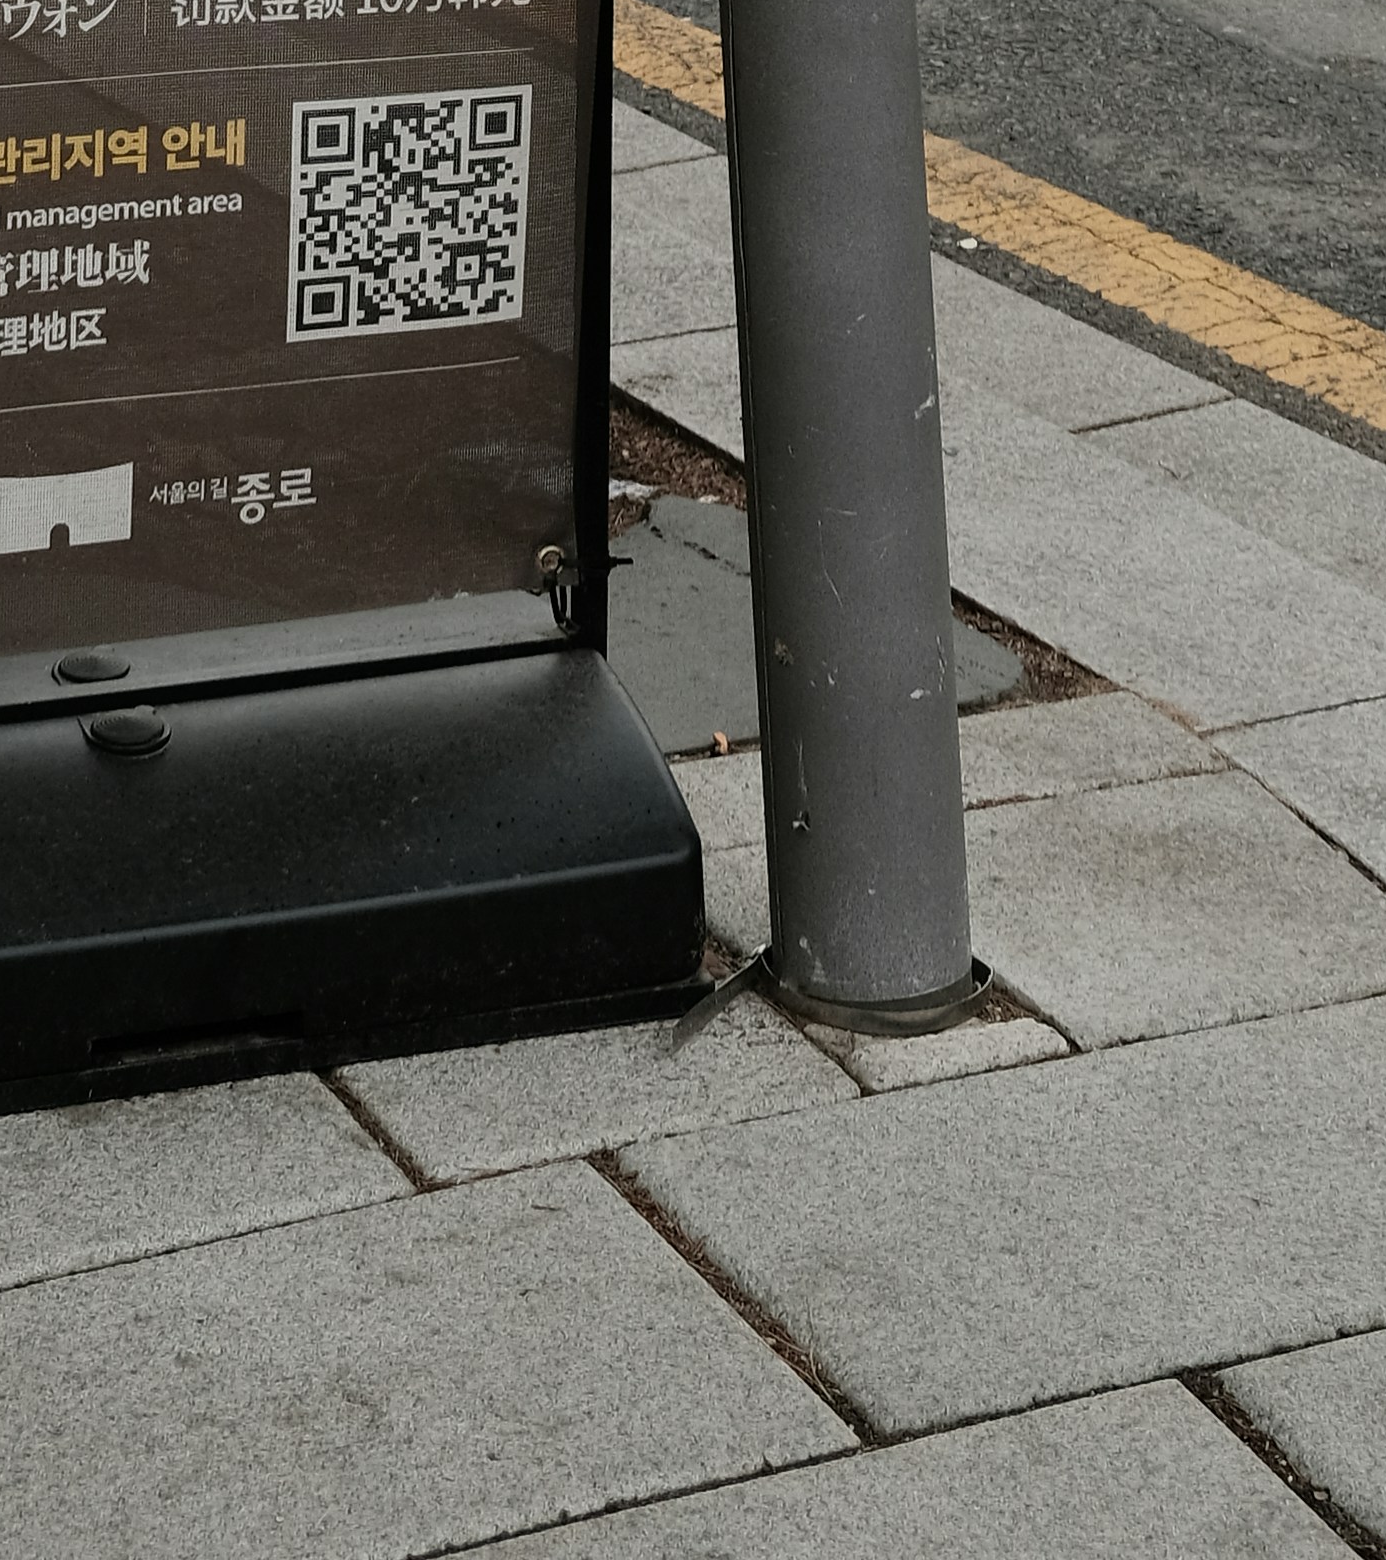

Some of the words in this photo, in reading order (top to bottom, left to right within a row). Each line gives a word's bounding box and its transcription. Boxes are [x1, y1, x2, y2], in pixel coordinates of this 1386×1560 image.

[162, 119, 246, 170] 안내
[7, 195, 182, 229] management
[188, 193, 242, 214] area
[150, 479, 204, 504] 서울의
[211, 477, 227, 499] 길
[231, 468, 316, 524] 종로
